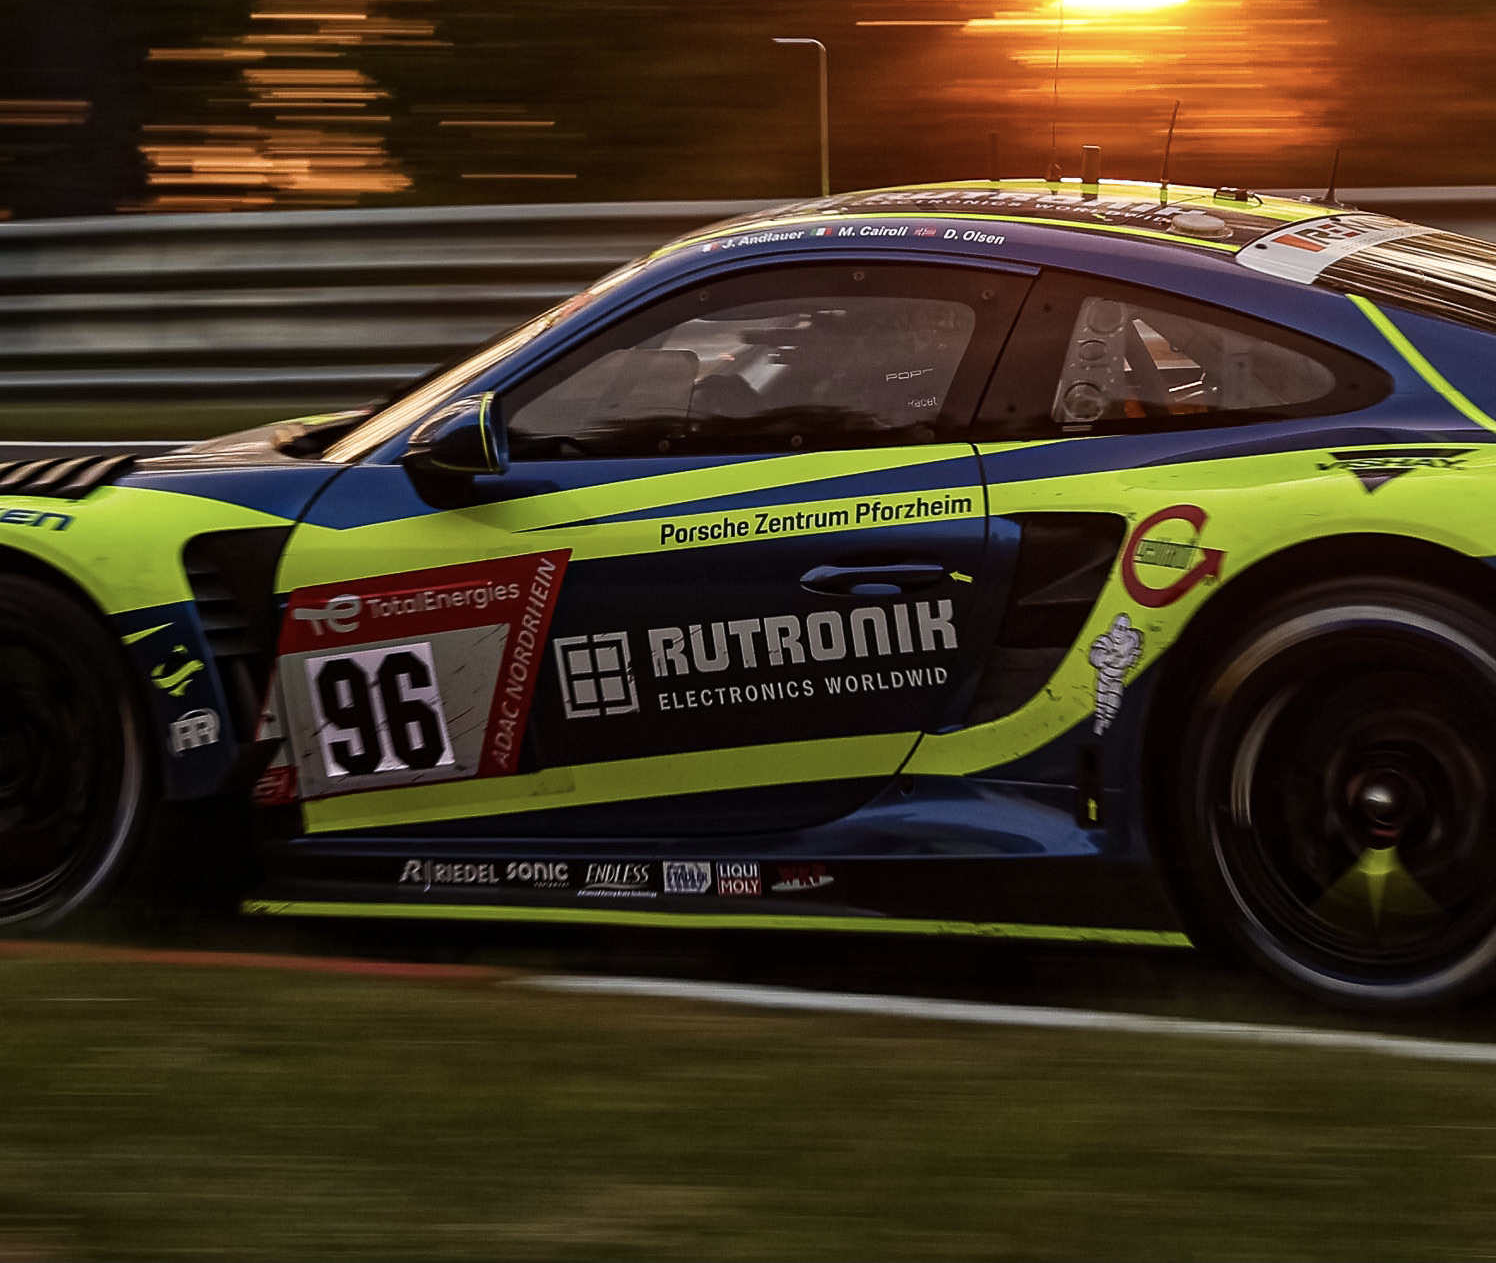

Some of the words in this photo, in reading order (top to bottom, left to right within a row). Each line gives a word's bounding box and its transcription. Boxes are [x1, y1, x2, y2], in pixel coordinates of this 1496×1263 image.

[721, 239, 736, 249] J.
[738, 231, 805, 246] Andlauer
[838, 226, 856, 237] M.
[859, 225, 909, 237] Cairoli
[943, 228, 959, 240] D.
[962, 230, 1005, 246] Olsen
[660, 517, 750, 545] Porsche
[754, 508, 850, 536] Zentrum
[855, 494, 973, 524] Pforzheim
[365, 581, 521, 619] TotalEnergies
[505, 558, 557, 695] NORDRHEIN
[647, 599, 959, 678] RUTRONIK
[658, 679, 815, 711] ELECTRONICS
[824, 667, 949, 694] WORLDWID
[316, 650, 447, 776] 96
[491, 701, 520, 770] ADAC
[434, 863, 500, 883] RIEDEL
[585, 862, 651, 884] ENDLESS
[719, 863, 759, 879] LIQUI
[721, 879, 760, 894] MOLY
